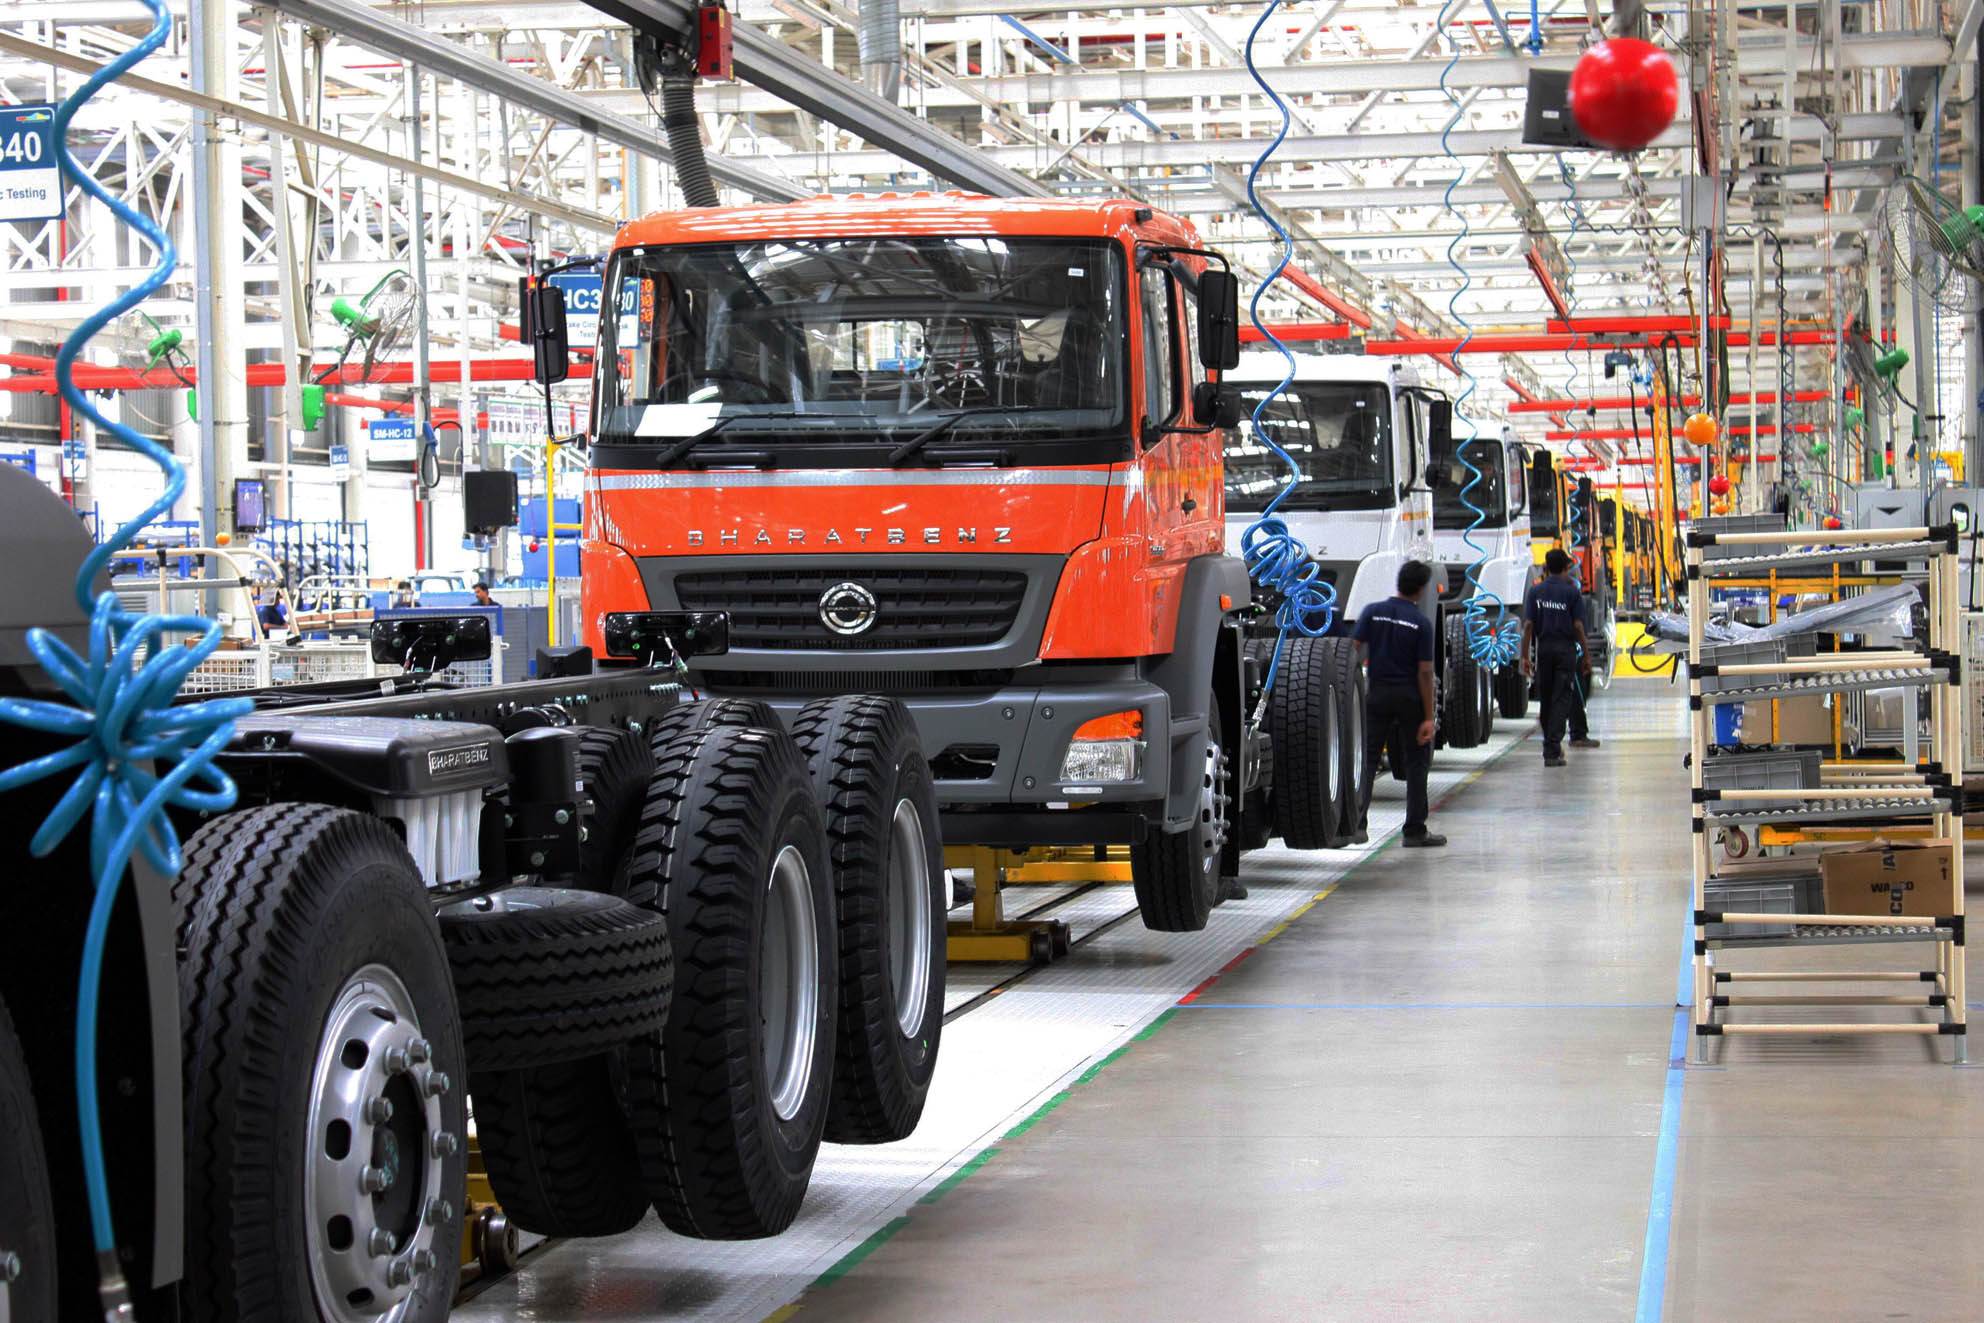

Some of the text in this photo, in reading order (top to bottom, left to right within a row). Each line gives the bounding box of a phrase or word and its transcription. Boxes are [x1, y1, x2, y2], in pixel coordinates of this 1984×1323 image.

[0, 132, 41, 162] 40
[7, 187, 46, 200] Testing
[687, 528, 1013, 547] BHARATBENZ
[431, 749, 489, 770] BHARATBENZ
